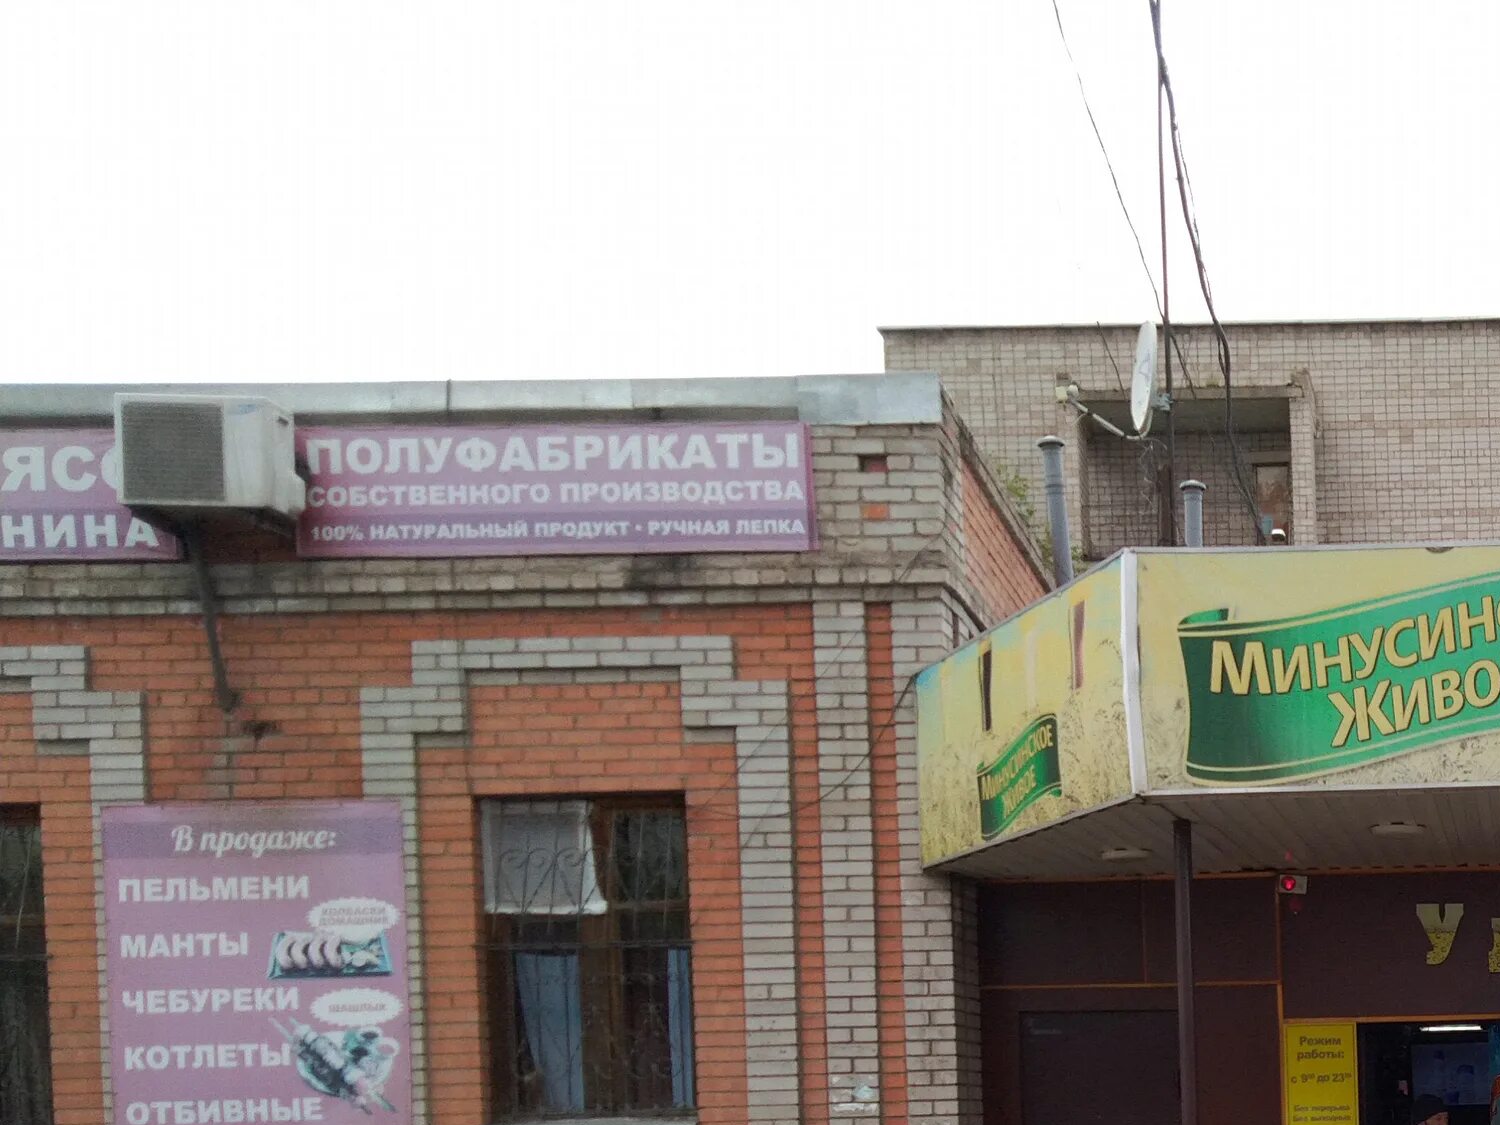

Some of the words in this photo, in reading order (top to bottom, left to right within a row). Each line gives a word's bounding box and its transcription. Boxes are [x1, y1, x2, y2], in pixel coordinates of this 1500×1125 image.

[305, 432, 799, 475] ПОЛУФАБРИКАТЫ
[307, 483, 550, 508] СОБСТВЕННОГО
[560, 480, 805, 505] ПРОИЗВОДСТВА
[1, 513, 160, 549] НИНА
[311, 526, 364, 541] 100%
[369, 520, 529, 540] НАТУРАЛЬНЫЙ
[534, 520, 631, 539] ПРОДУКТ
[649, 519, 731, 537] РУЧНАЯ
[735, 518, 806, 535] ЛЕПКА
[171, 824, 194, 853] В
[200, 827, 337, 859] продаже:
[118, 875, 311, 903] ПЕЛЬМЕНИ
[119, 932, 249, 960] МАНТЫ
[1415, 903, 1465, 965] У
[121, 986, 300, 1016] ЧЕБУРЕКИ
[1299, 1035, 1343, 1047] Режим
[123, 1043, 292, 1072] КОТЛЕТЫ
